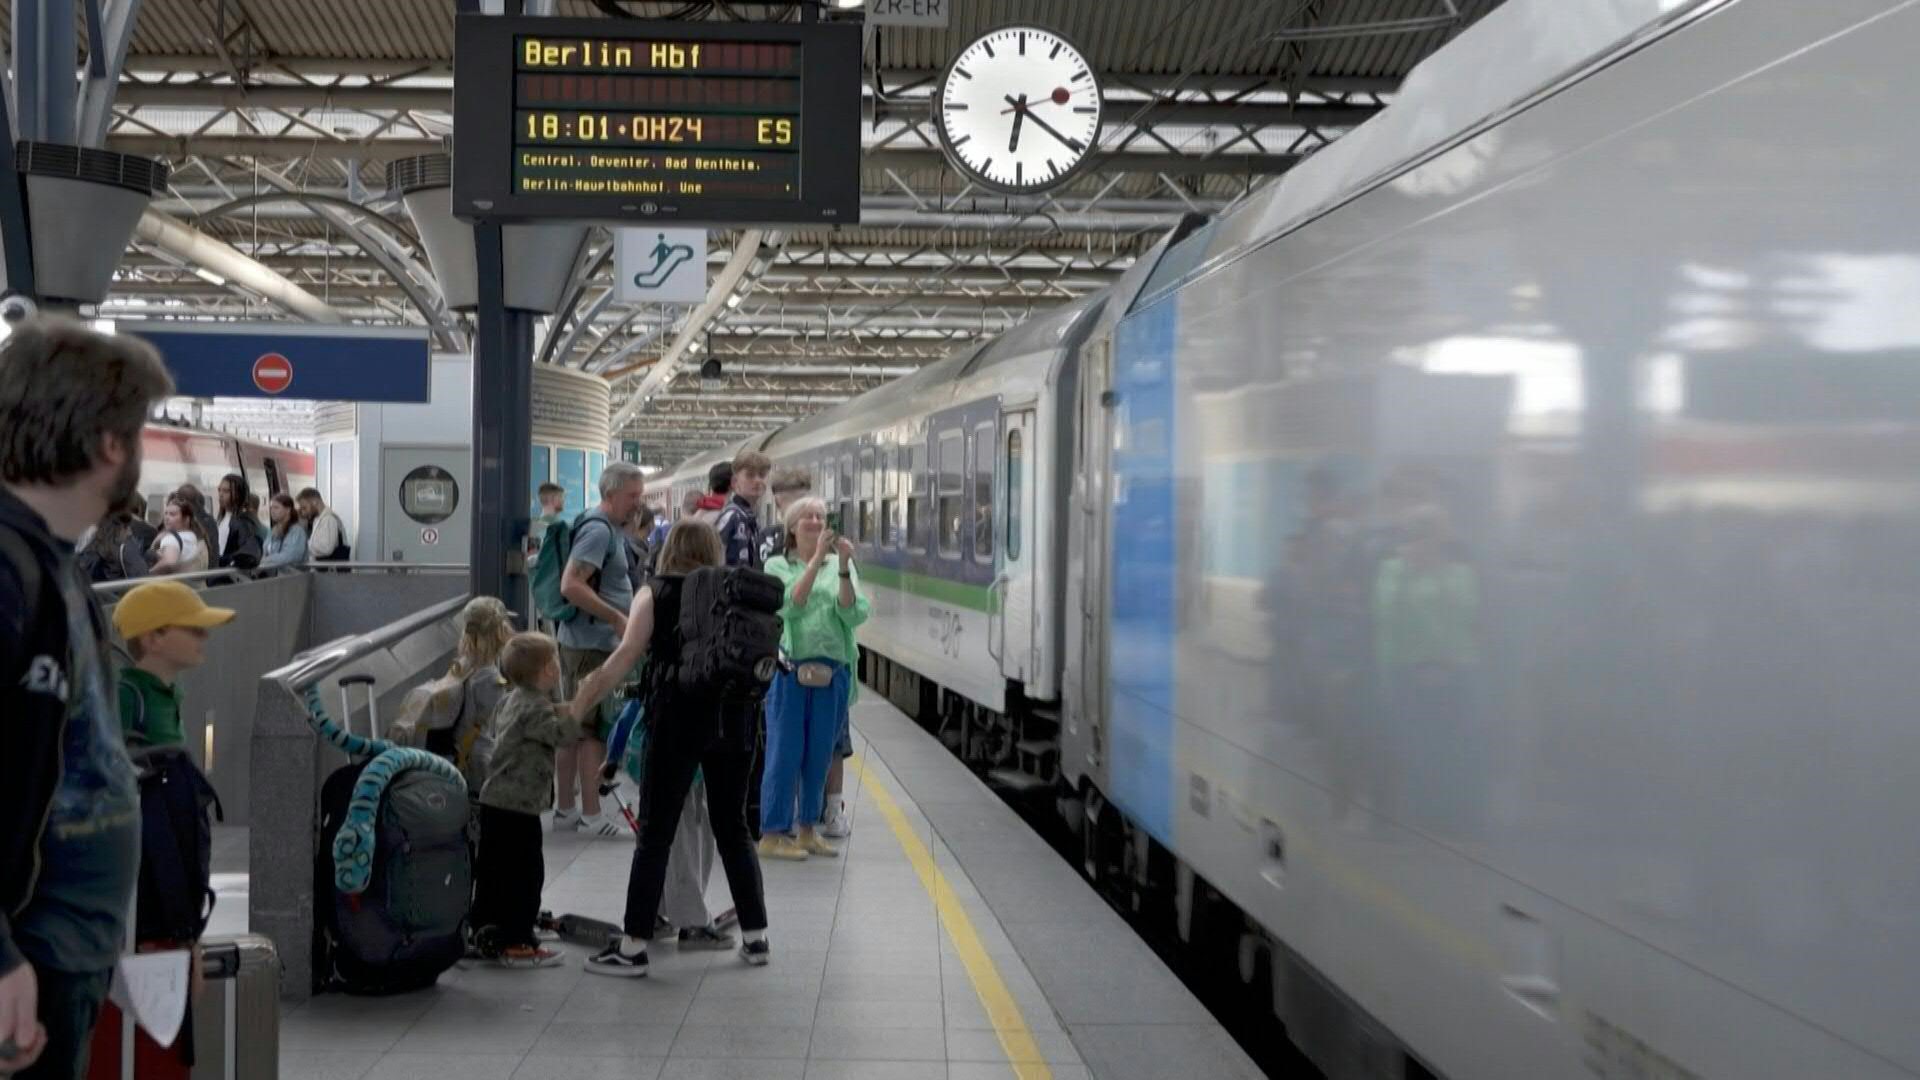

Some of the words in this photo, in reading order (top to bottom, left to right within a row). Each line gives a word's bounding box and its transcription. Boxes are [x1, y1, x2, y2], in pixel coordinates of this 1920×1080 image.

[525, 39, 632, 67] Berlin
[651, 43, 701, 69] Hbf
[527, 113, 609, 139] 18:01
[757, 119, 792, 145] ES
[665, 156, 688, 169] Bad
[679, 180, 703, 194] Une
